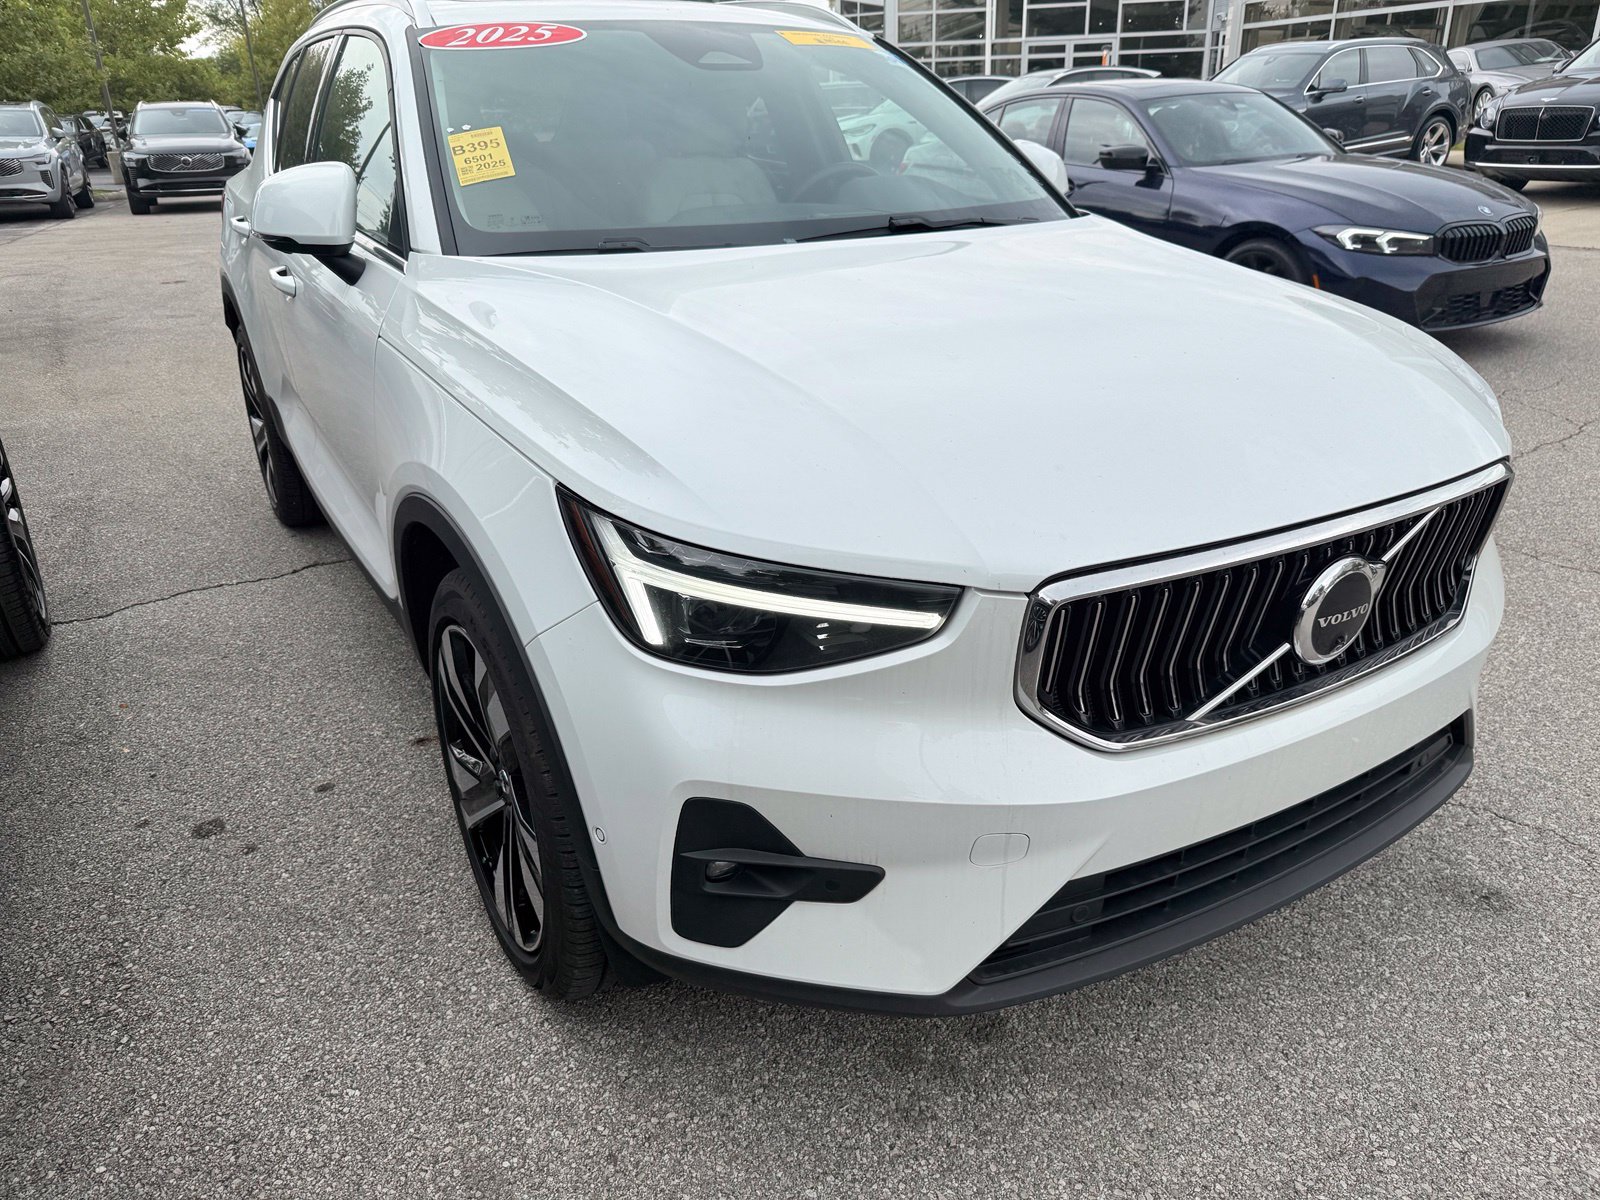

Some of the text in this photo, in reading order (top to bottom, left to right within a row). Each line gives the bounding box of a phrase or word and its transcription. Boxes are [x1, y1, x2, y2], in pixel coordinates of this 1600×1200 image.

[446, 25, 558, 47] 2025
[451, 138, 501, 156] B395
[464, 153, 493, 165] 6501
[475, 159, 506, 171] 2025
[1318, 603, 1369, 628] VOLVO
